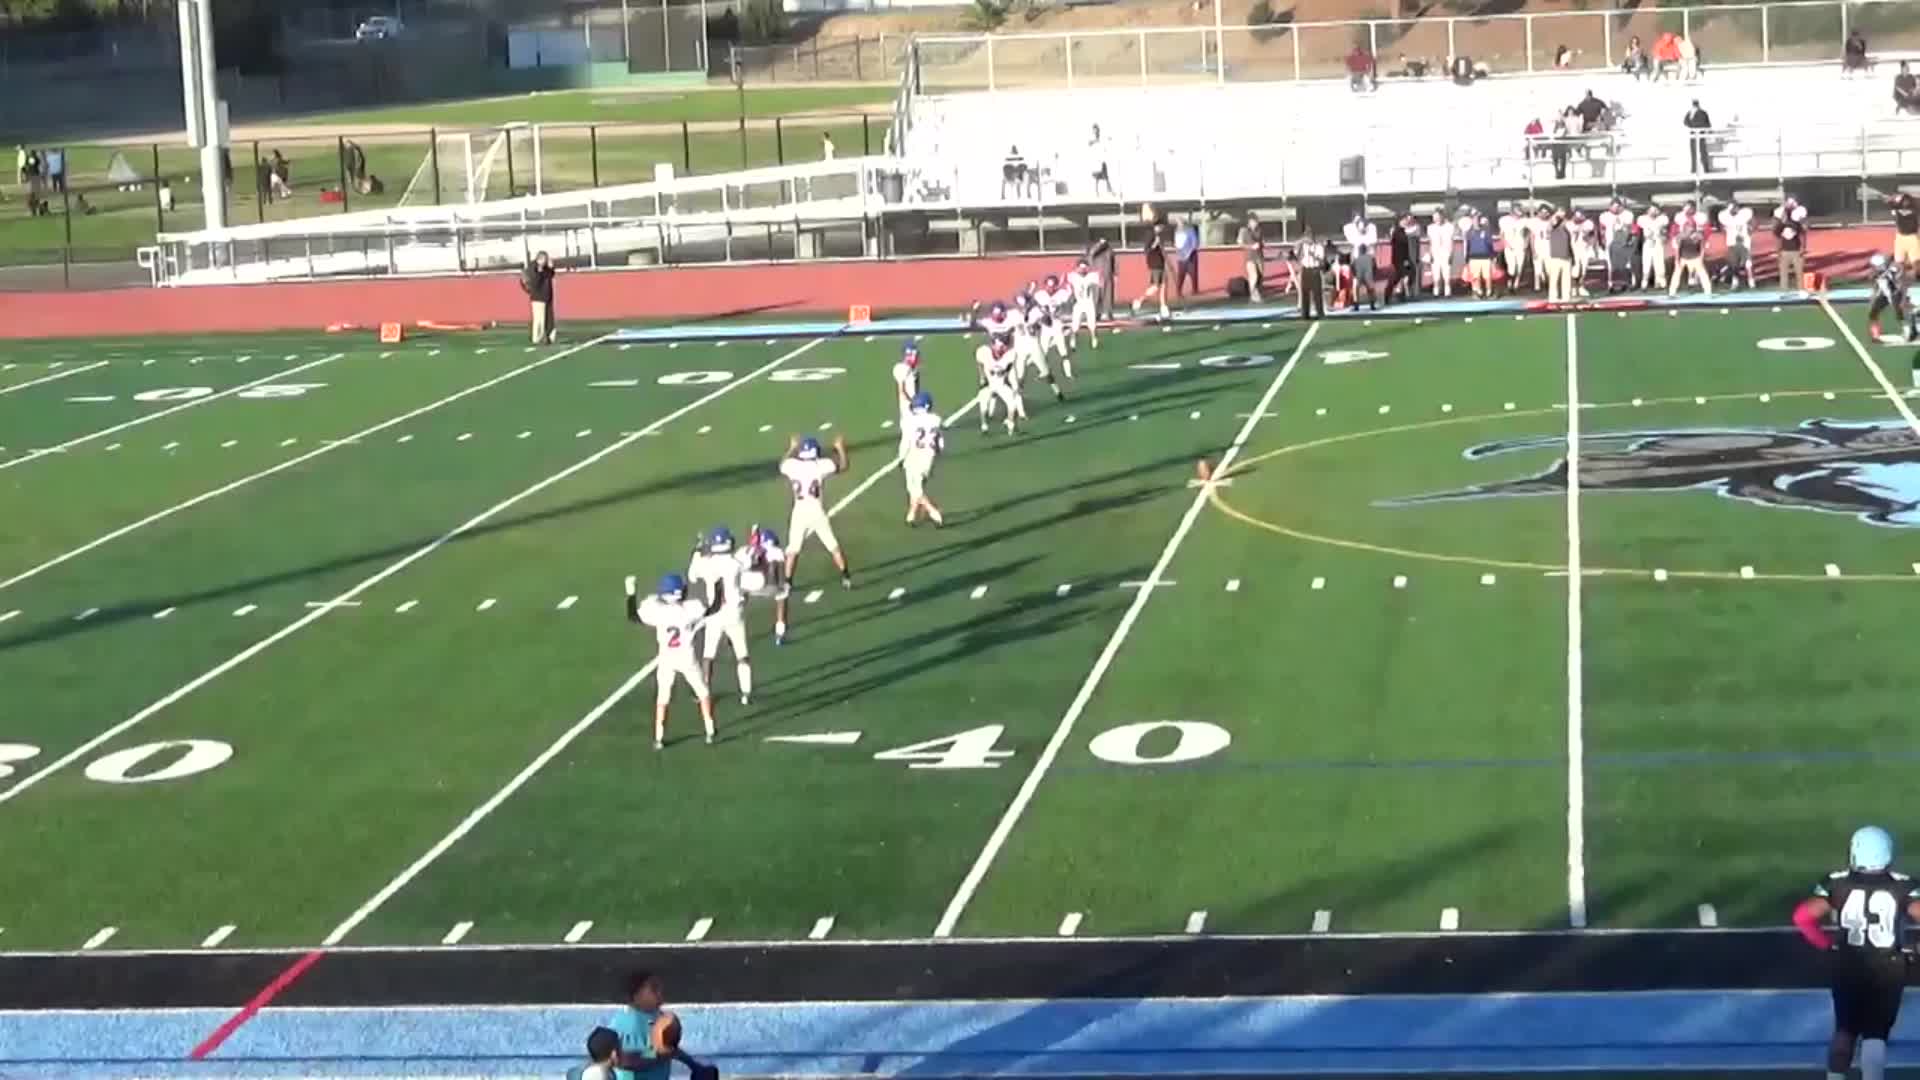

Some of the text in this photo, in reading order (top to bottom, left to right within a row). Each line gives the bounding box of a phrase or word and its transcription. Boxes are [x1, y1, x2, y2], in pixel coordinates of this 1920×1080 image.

[915, 427, 939, 450] 23
[791, 479, 820, 499] 24
[874, 720, 1231, 767] 40
[1841, 889, 1897, 948] 43
